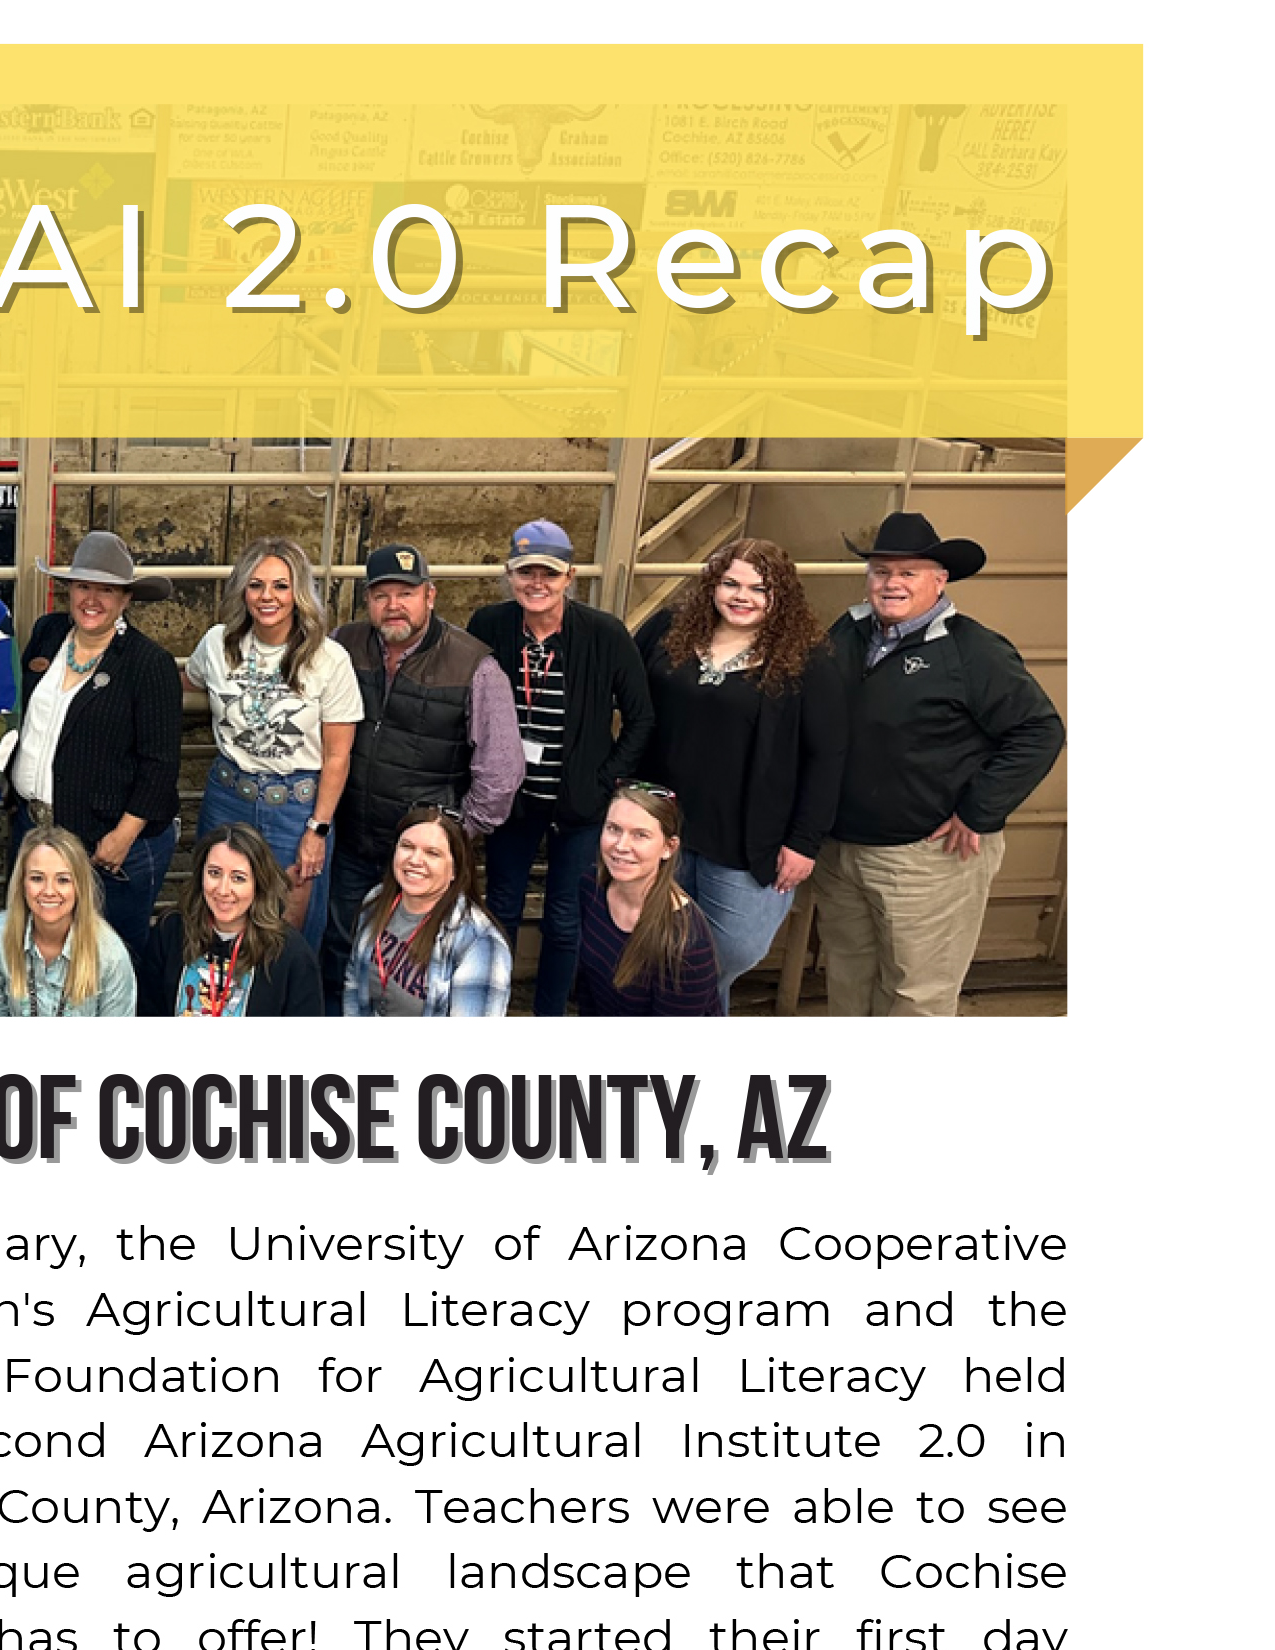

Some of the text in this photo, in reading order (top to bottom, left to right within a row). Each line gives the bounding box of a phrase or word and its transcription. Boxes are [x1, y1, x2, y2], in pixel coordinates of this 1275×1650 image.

[665, 115, 694, 128] 1081
[715, 116, 749, 129] Birch
[753, 117, 789, 129] Road
[461, 130, 509, 144] Cochise
[560, 131, 609, 144] Graham
[726, 132, 743, 144] AZ
[418, 150, 456, 165] Cattle
[659, 151, 704, 164] Office:
[224, 204, 455, 308] 2.0
[547, 205, 1046, 335] Recap
[987, 306, 1036, 330] ervice
[100, 1074, 393, 1159] COCHISE
[419, 1074, 713, 1170] COUNTY,
[738, 1075, 826, 1158] AZ
[117, 1225, 195, 1260] the
[231, 1225, 464, 1269] University
[495, 1225, 541, 1260] of
[568, 1225, 745, 1260] Arizona
[781, 1225, 1066, 1269] Cooperative
